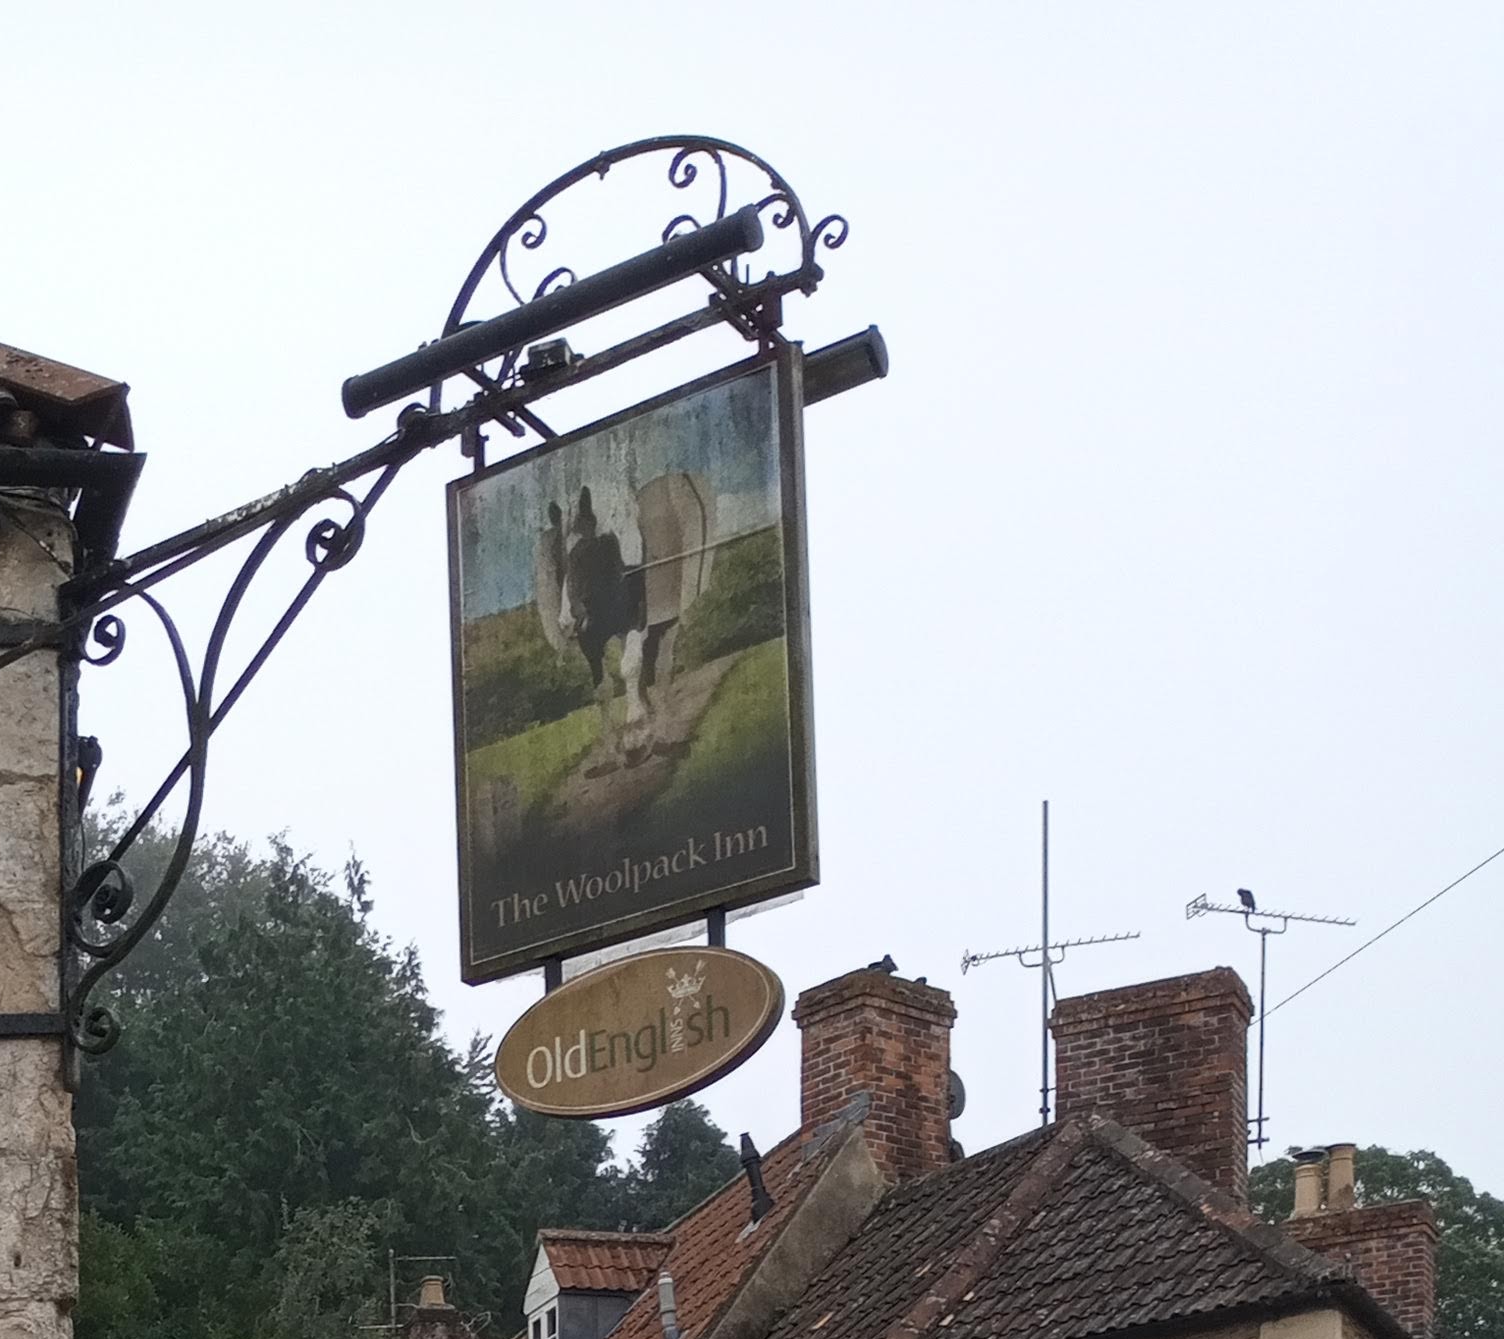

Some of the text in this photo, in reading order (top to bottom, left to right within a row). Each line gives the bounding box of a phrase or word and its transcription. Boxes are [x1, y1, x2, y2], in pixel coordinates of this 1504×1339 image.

[491, 825, 769, 928] The Woolpack Inn
